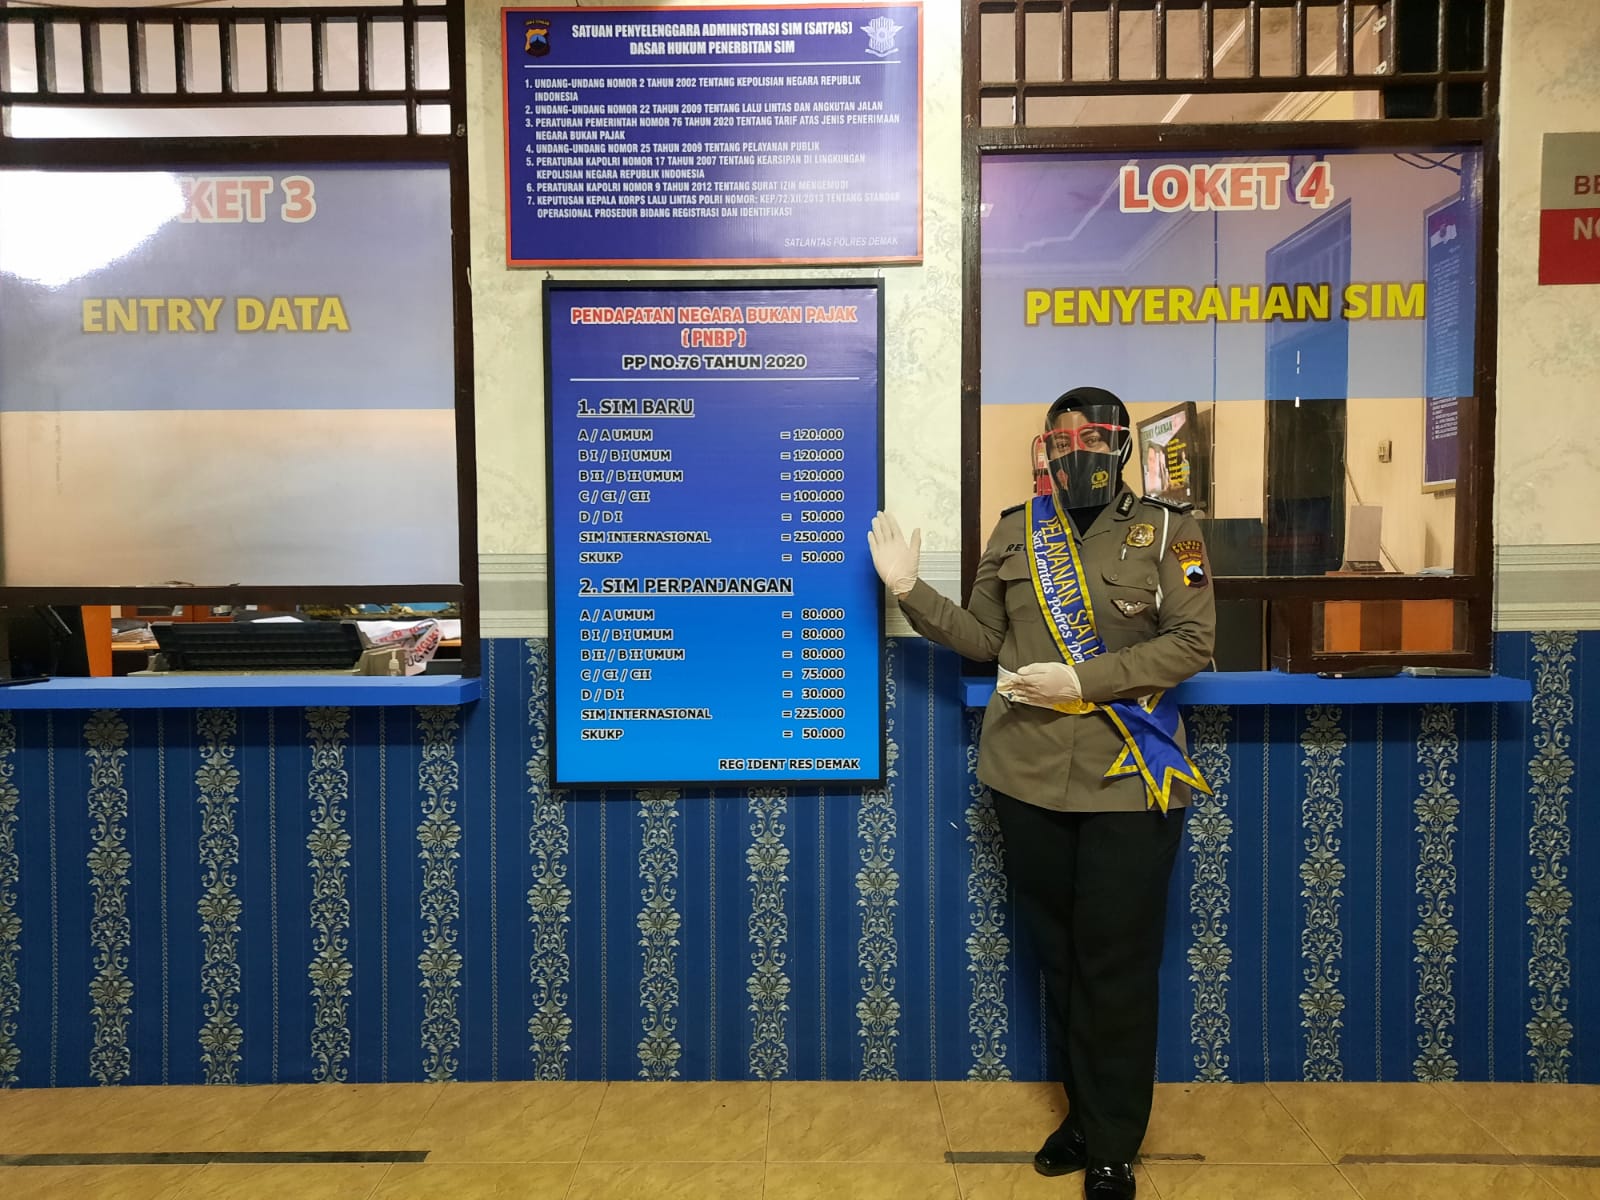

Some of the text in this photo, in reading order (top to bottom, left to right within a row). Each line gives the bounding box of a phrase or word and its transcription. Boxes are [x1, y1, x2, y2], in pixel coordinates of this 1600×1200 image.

[572, 22, 852, 38] SATUAN PENYELENGGARA ADMINISTRASI SIM (SATPAS)
[630, 41, 794, 55] DASAR HUKUM PENERBITAN SIM
[535, 75, 860, 89] UNDANG-UNDANG NOMOR TAHUN 2002 TENTANG KEPOLISIAN NEGARA REPUBLIK
[535, 92, 578, 102] INDONESIA
[535, 101, 882, 114] UNDANG-UNDANG NOMOR 22 TAHUN 2009 TENTANG LALU LINTAS DAN ANGKUTAN JALAN
[536, 114, 899, 127] PERATURAN PEMERINTAH NOMOR 76 TAHUN 2020 TENTANG TARIF ATAS JENIS PENERIMAAN
[536, 130, 625, 140] NEGARA BUKAN PAJAK
[536, 142, 819, 153] UNDANG-UNDANG NOMOR 25 TAHUN 2009 TENTANG PELAYANAN PUBLIK
[537, 156, 582, 167] PERATURAN
[586, 156, 620, 166] KAPOLRI
[623, 155, 652, 166] NOMOR
[656, 155, 665, 165] 17
[668, 155, 693, 165] TAHUN
[697, 155, 716, 165] 2007
[719, 154, 754, 165] TENTANG
[537, 169, 704, 179] KEPOLISIAN NEGARA REPUBLIK INDONESIA
[537, 180, 776, 193] PERATURAN KAPOLRI NOMOR TAHUN 2012 TENTANG SURAT
[1119, 161, 1334, 214] LOKET 4
[281, 175, 316, 223] 3
[538, 195, 584, 205] KEPUTUSAN
[587, 195, 616, 205] KEPALA
[619, 195, 645, 205] KORPS
[648, 194, 667, 204] LALU
[670, 194, 697, 204] LINTAS
[699, 194, 722, 204] POLRI
[538, 207, 791, 218] OPERASIONAL PROSEDUR BIDANG REGISTRASI DAN IDENTIFIKASI
[1573, 216, 1600, 241] N
[1024, 283, 1427, 326] PENYERAHAN SIM
[82, 297, 350, 333] ENTRY DATA
[570, 307, 857, 324] PENDAPATAN NEGARA BUKAN PAJAK
[622, 355, 807, 370] PP NO.76 TAHUN 2020
[578, 399, 694, 415] 1. SIM BARU
[612, 430, 652, 441] UMUM
[793, 430, 844, 441] 120.000
[631, 450, 671, 461] UMUM
[793, 450, 844, 461] 120.000
[642, 470, 682, 482] UMUM
[793, 470, 844, 482] 120.000
[601, 491, 650, 502] CI CII
[793, 491, 844, 502] 100.000
[801, 511, 844, 522] 50.000
[579, 532, 711, 543] SIM INTERNASIONAL
[794, 532, 844, 543] 250.000
[1032, 530, 1043, 550] Sat
[1005, 543, 1026, 553] RE
[579, 552, 622, 563] SKUKP
[802, 552, 844, 563] 50.000
[1038, 516, 1082, 608] PELAYANAN
[1034, 551, 1054, 594] Lantas
[580, 578, 792, 593] 2. SIM PERPANJANGAN
[614, 610, 654, 621] UMUM
[801, 609, 844, 620] 80.000
[1047, 596, 1073, 639] Polres
[632, 629, 672, 640] UMUM
[801, 629, 844, 640] 80.000
[644, 649, 684, 661] UMUM
[801, 649, 844, 660] 80.000
[602, 669, 651, 681] CI CII
[802, 669, 844, 680] 75.000
[802, 689, 844, 700] 30.000
[581, 709, 712, 720] SIM INTERNASIONAL
[795, 708, 844, 719] 225.000
[581, 729, 623, 740] SKUKP
[802, 728, 844, 739] 50.000
[719, 759, 860, 770] REG IDENT RES DEMAK
